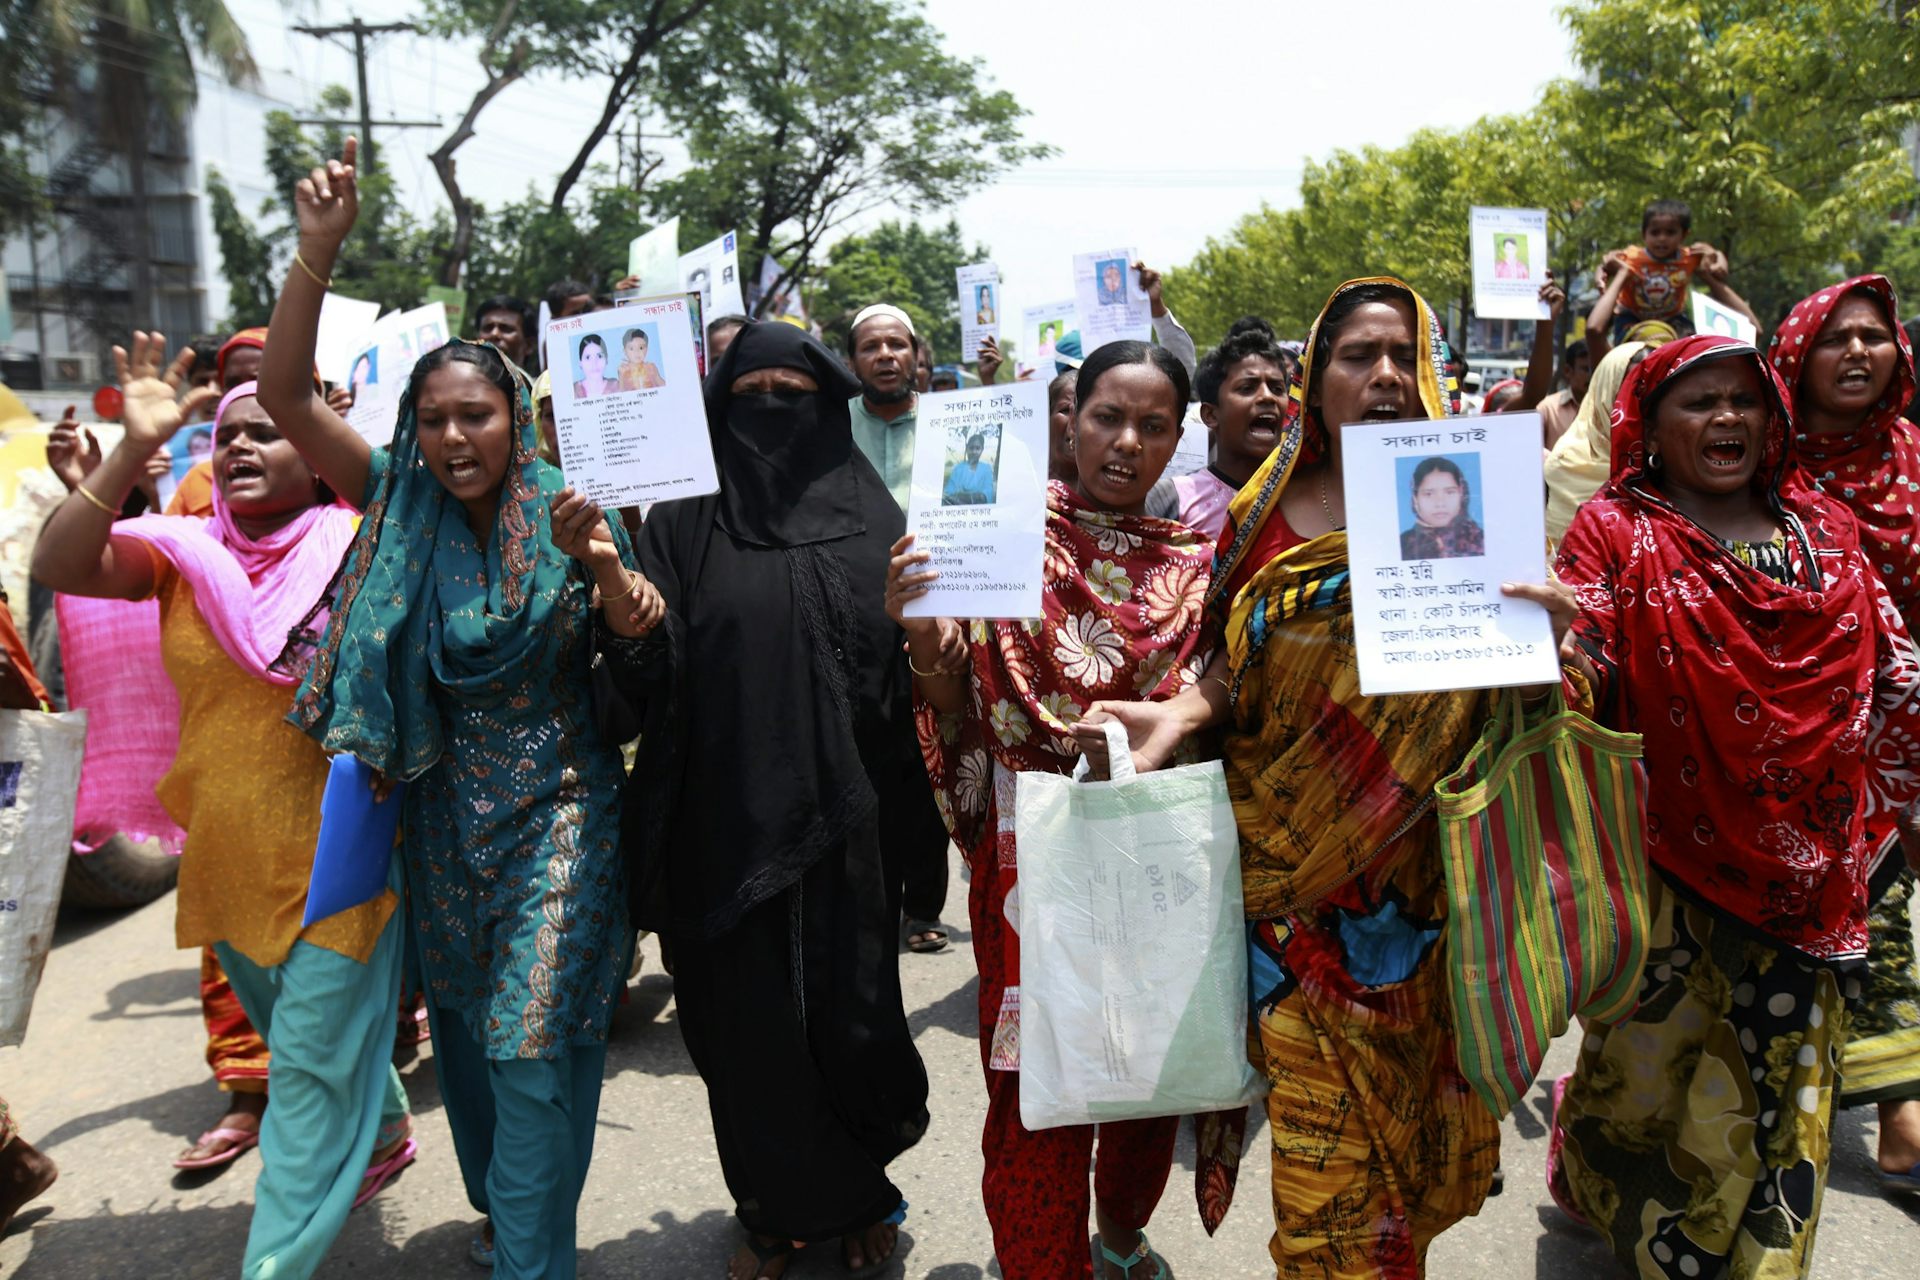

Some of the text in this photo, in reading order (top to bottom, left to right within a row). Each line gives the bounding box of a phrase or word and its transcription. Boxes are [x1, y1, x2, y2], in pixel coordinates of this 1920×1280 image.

[643, 301, 683, 316] সন্ধান চাই
[549, 318, 583, 333] সন্ধান চাই
[944, 394, 1013, 412] সন্ধান চাই
[1381, 428, 1488, 448] সন্ধান চাই
[1409, 560, 1433, 580] মুন্নি
[1424, 603, 1454, 619] কোট
